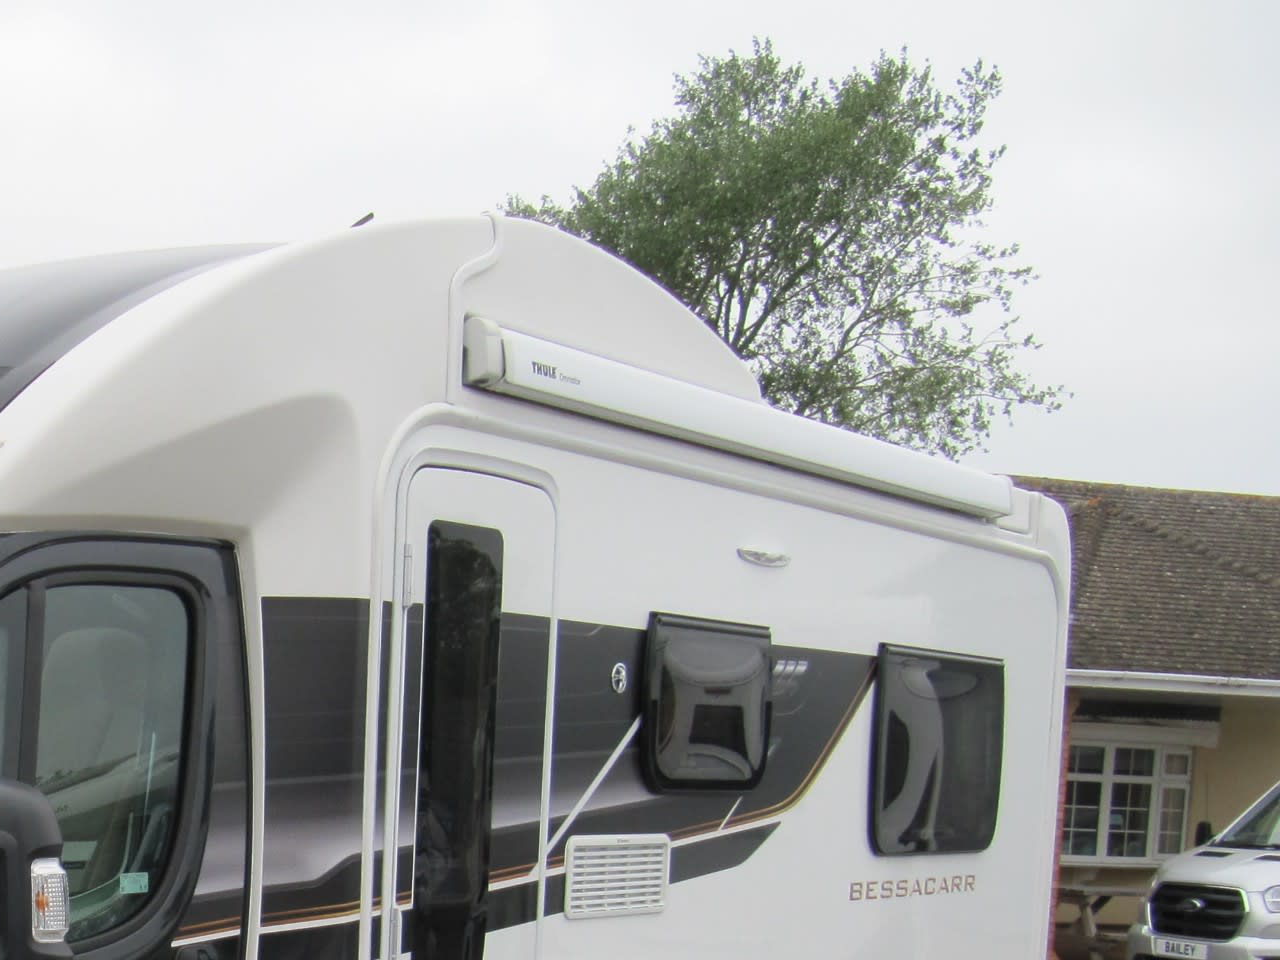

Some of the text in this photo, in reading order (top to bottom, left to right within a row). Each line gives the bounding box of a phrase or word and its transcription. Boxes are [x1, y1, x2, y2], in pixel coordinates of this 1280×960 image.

[531, 361, 557, 380] THULE
[849, 874, 976, 901] BESSACARR
[1164, 941, 1196, 956] BAILEY
